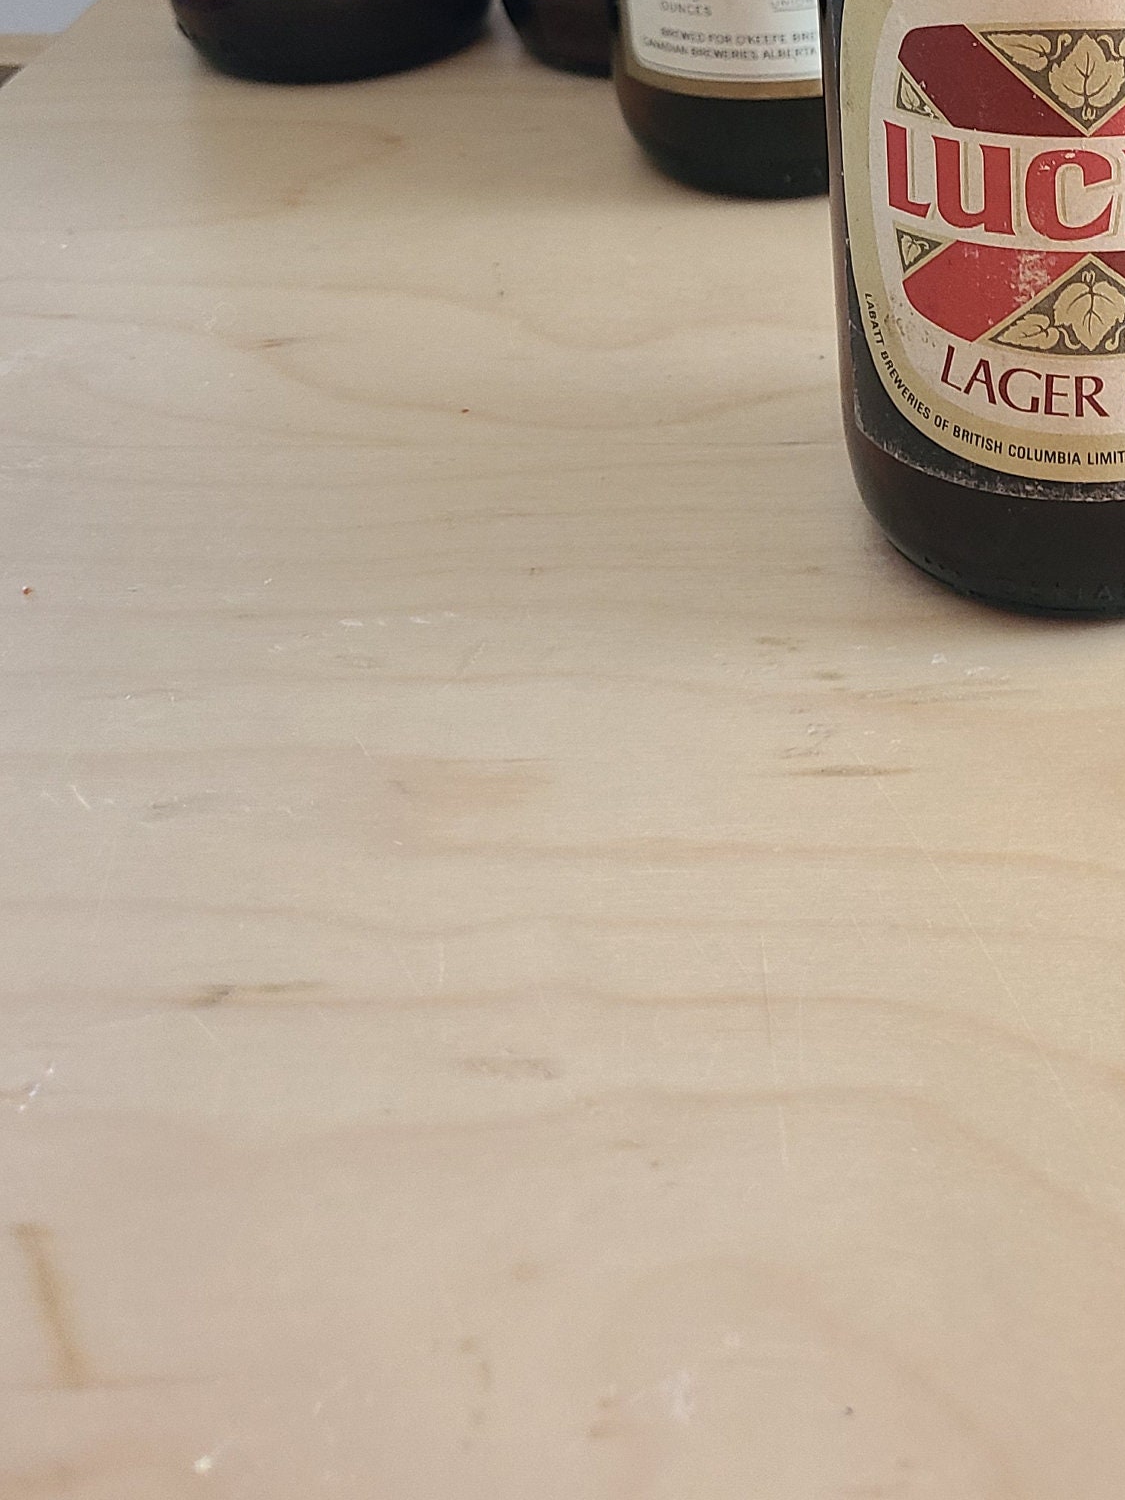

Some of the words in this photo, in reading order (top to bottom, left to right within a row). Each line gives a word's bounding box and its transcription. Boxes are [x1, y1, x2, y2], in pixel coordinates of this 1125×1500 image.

[659, 1, 712, 17] OUNCES
[660, 27, 705, 44] BREWED
[708, 33, 732, 45] FOR
[792, 31, 816, 43] BRE
[691, 48, 759, 61] BREWERIES
[864, 292, 885, 347] LABATT
[880, 350, 932, 420] BREWERIES
[933, 415, 950, 431] OF
[952, 424, 1003, 455] BRITISH
[1008, 443, 1082, 466] COLUMBIA
[940, 344, 1111, 418] LAGER
